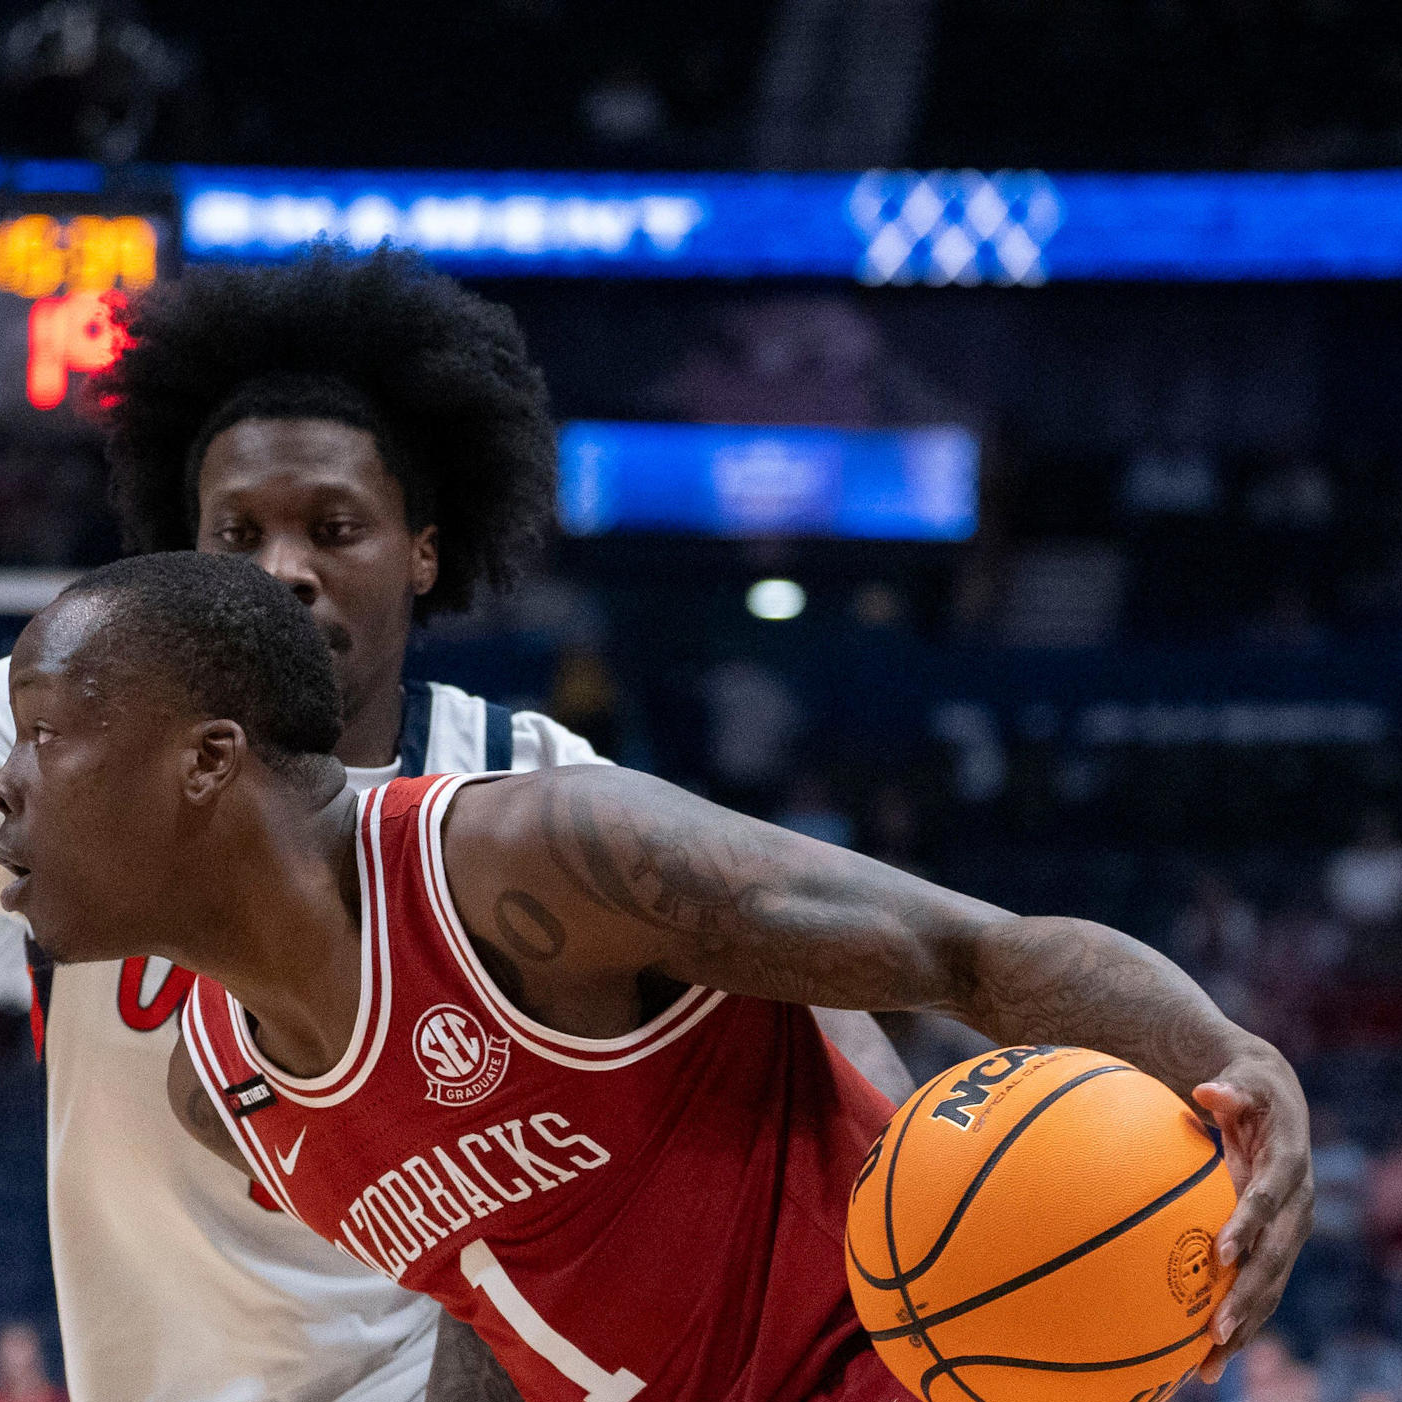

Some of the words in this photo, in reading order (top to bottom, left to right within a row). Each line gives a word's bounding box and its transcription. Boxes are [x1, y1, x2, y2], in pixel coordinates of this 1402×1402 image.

[420, 1013, 480, 1078] SEC
[446, 1057, 502, 1101] GRADUATE
[334, 1112, 612, 1283] AZORBACKS
